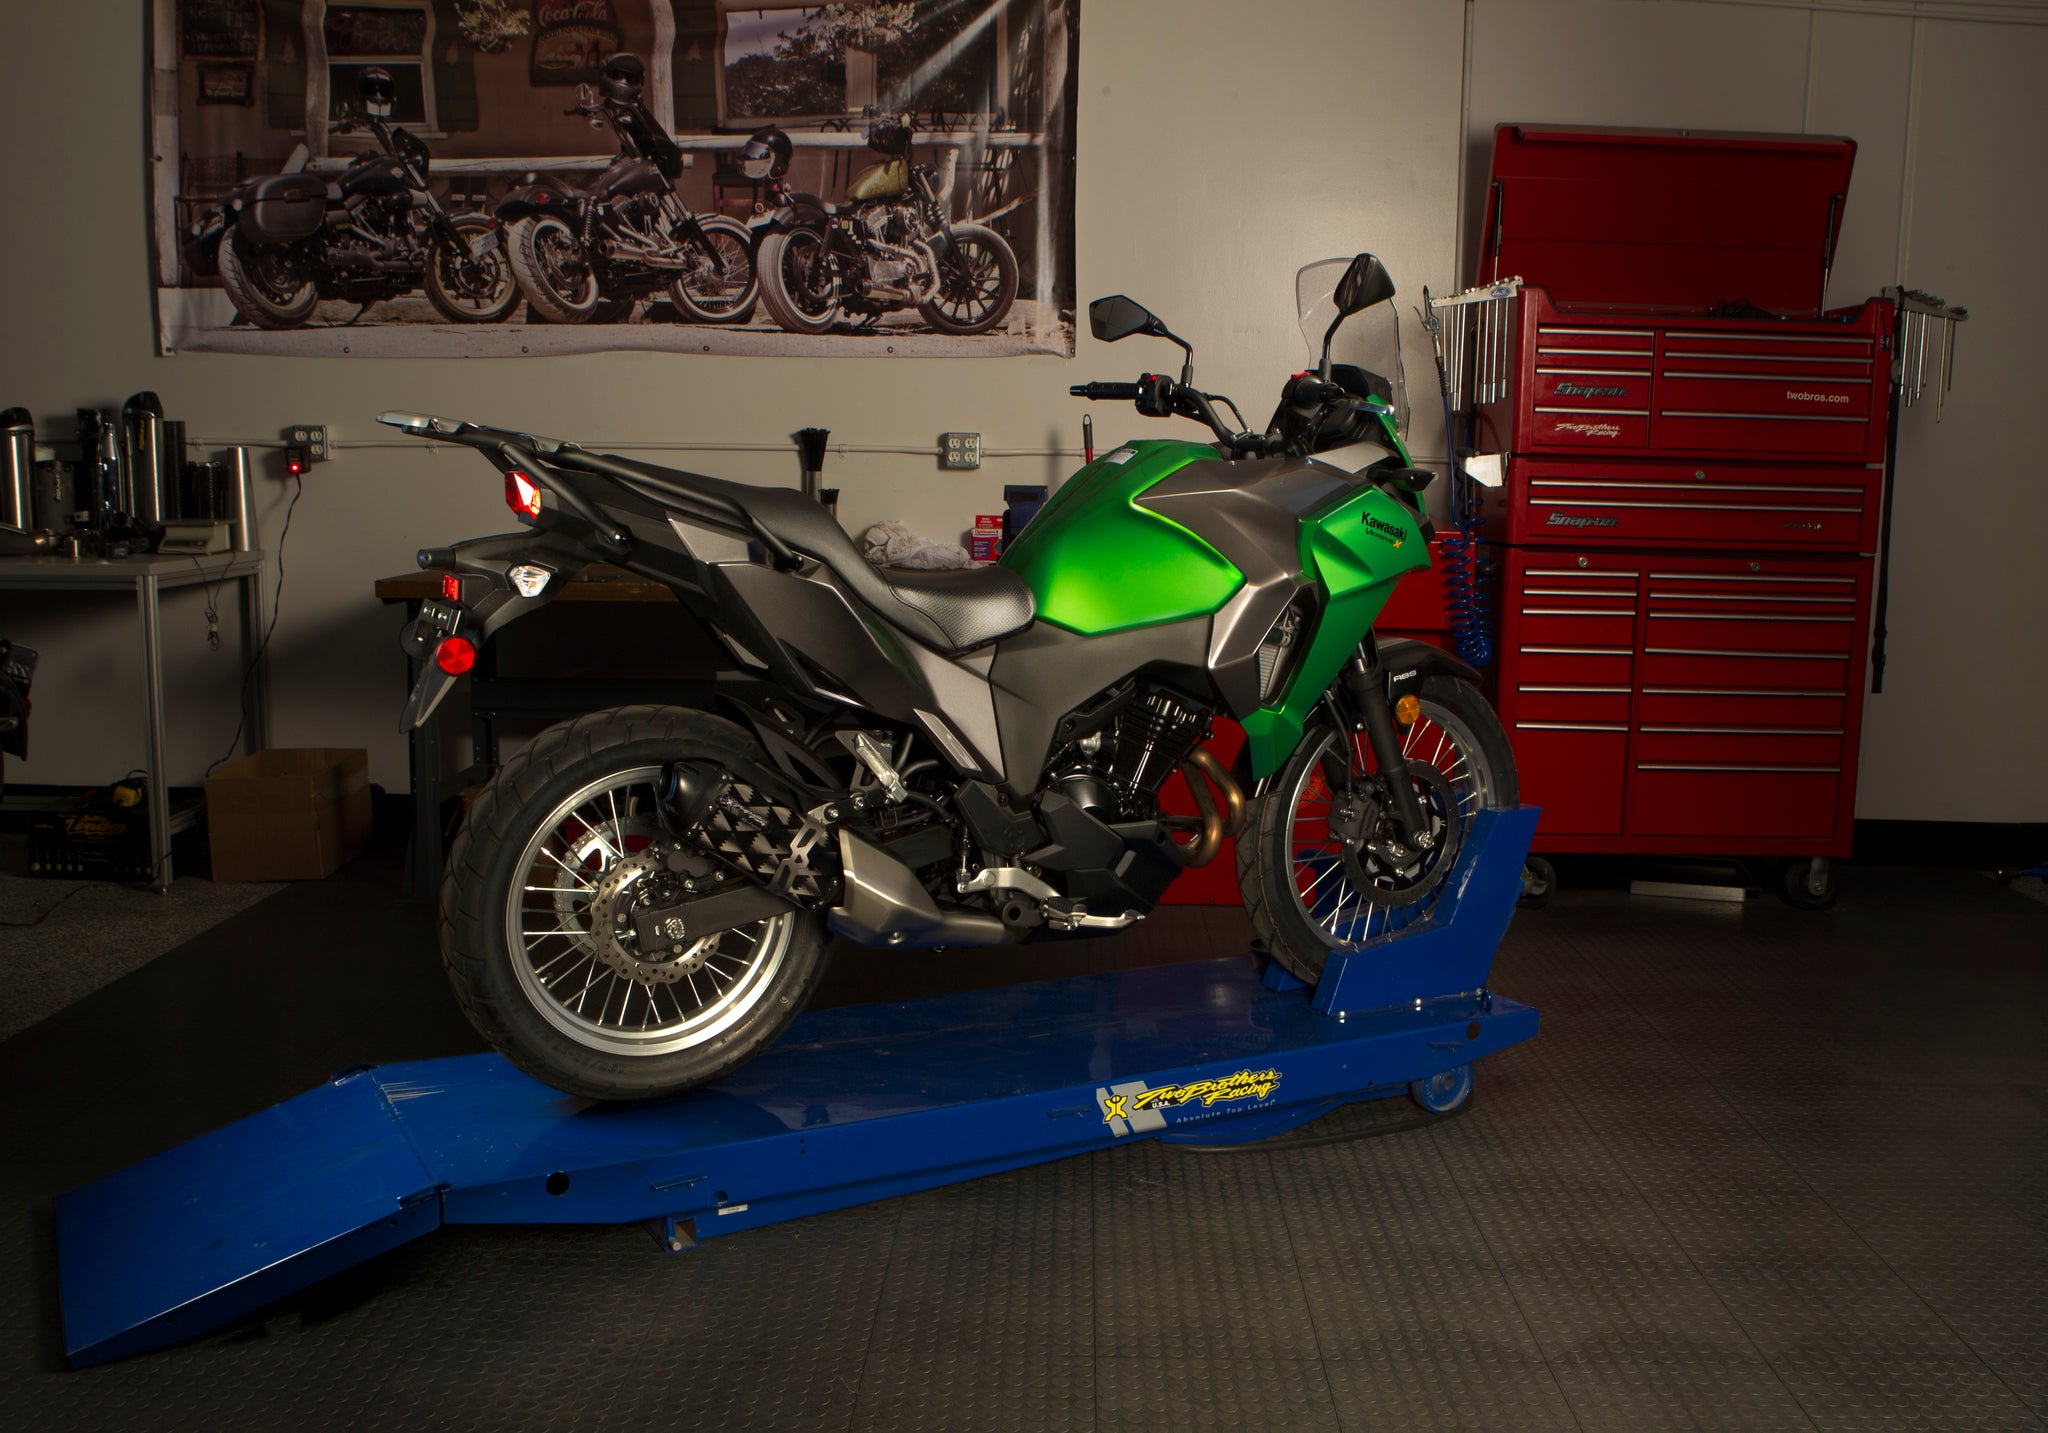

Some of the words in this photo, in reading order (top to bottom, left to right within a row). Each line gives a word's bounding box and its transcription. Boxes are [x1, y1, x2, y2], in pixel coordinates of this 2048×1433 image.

[1786, 390, 1850, 403] twobros.com
[1361, 511, 1408, 542] Kawasaki
[1546, 512, 1618, 528] Snap-on
[1201, 1081, 1278, 1107] Racing
[1176, 1110, 1221, 1125] Absolute
